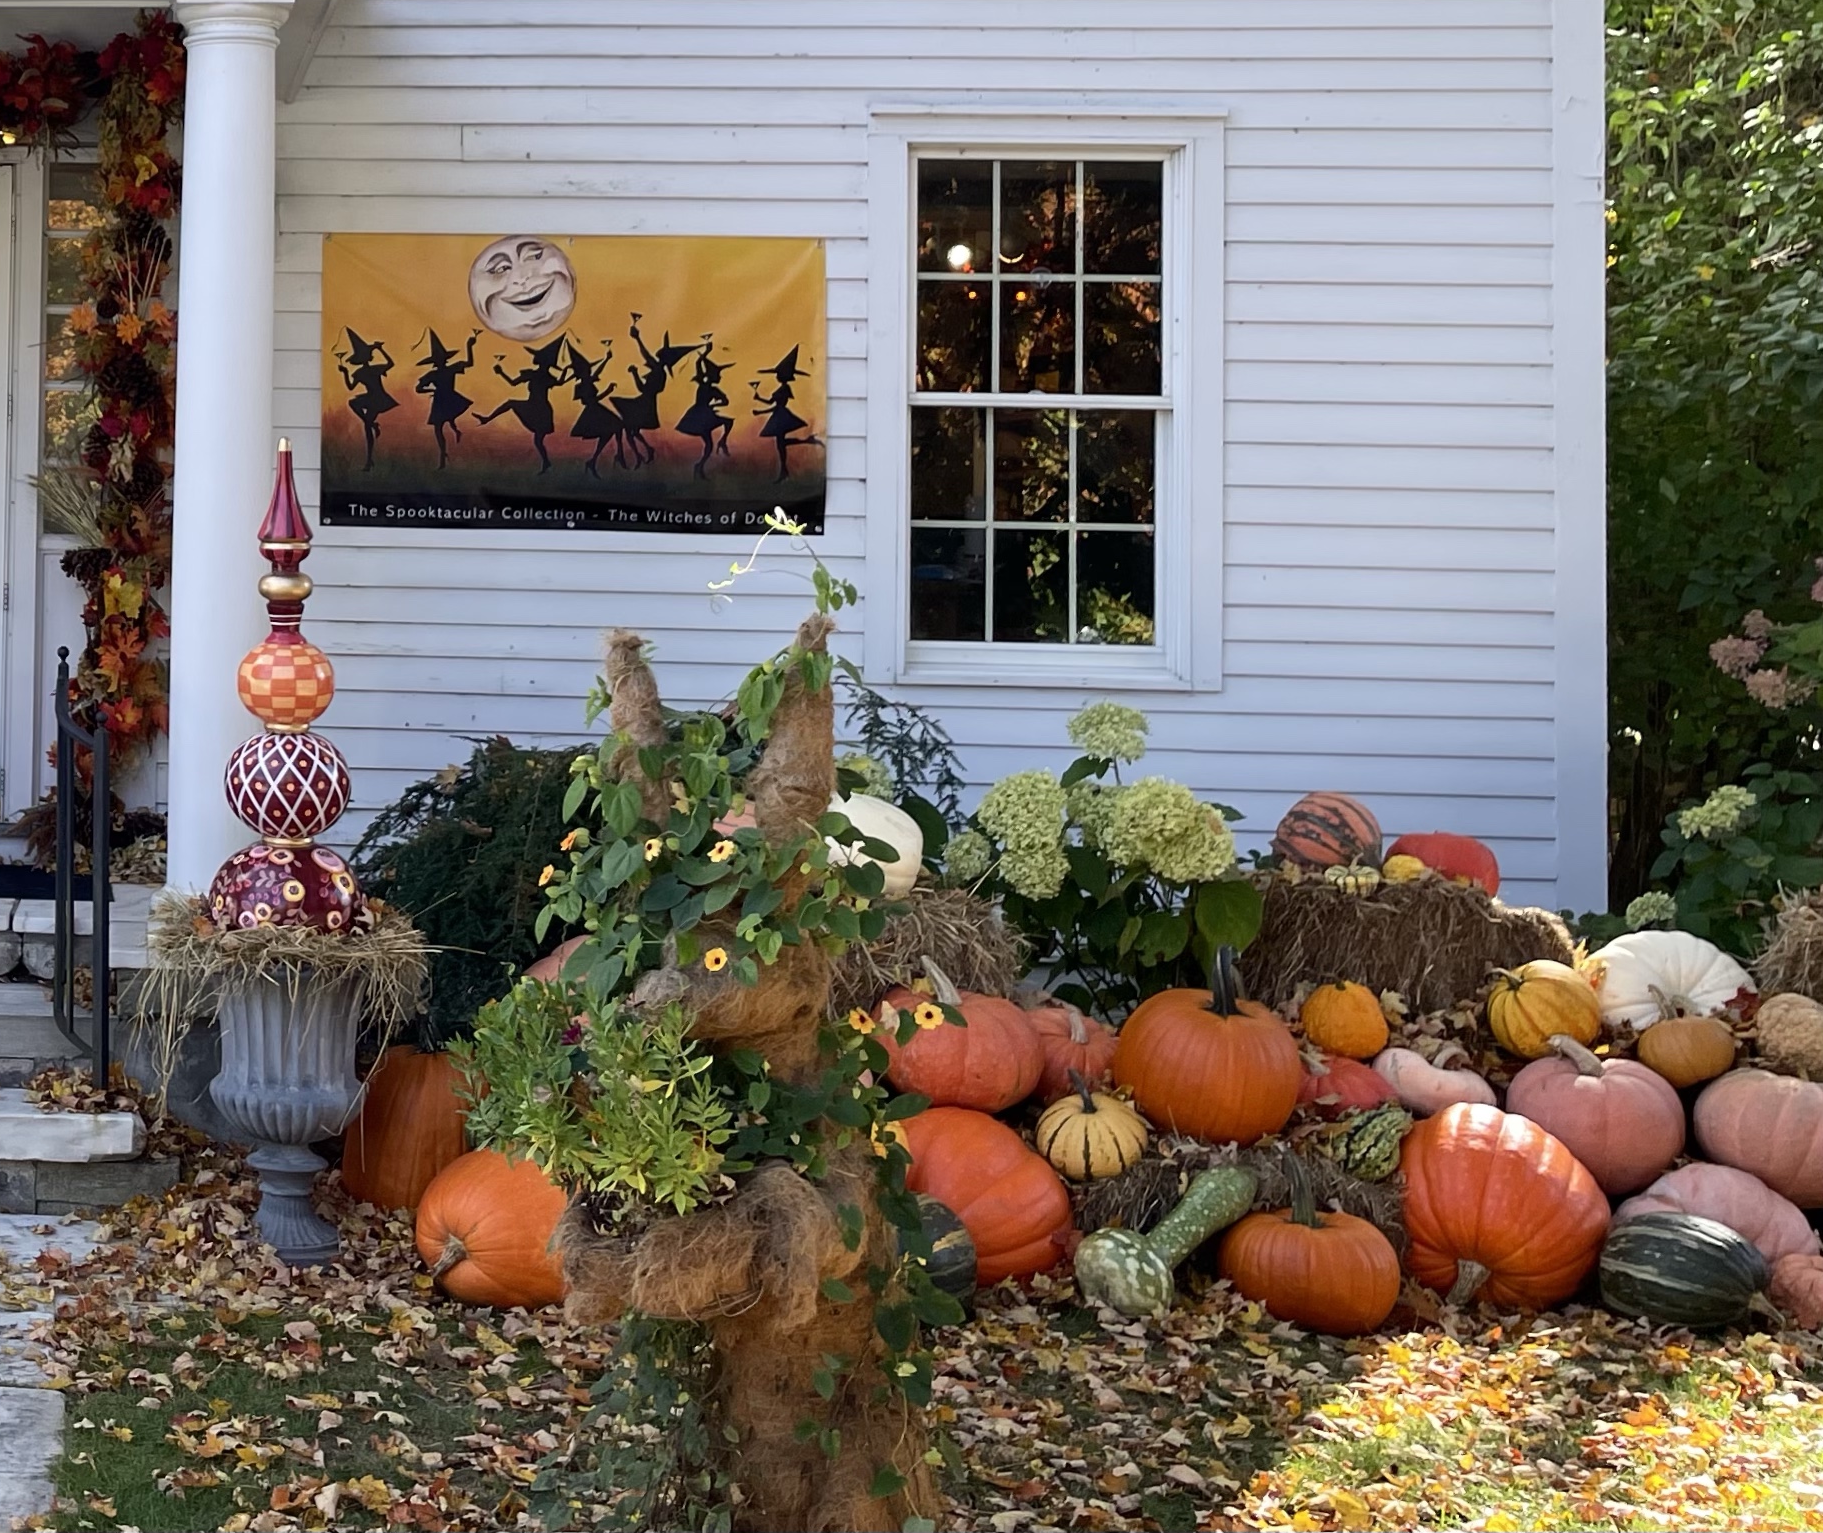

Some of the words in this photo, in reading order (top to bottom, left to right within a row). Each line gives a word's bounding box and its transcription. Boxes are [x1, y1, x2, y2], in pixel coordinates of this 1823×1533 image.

[348, 503, 378, 517] The
[385, 504, 494, 520] Spooktacular
[501, 506, 585, 520] Collection
[608, 509, 638, 522] The
[646, 509, 712, 524] Witches
[720, 510, 737, 524] of
